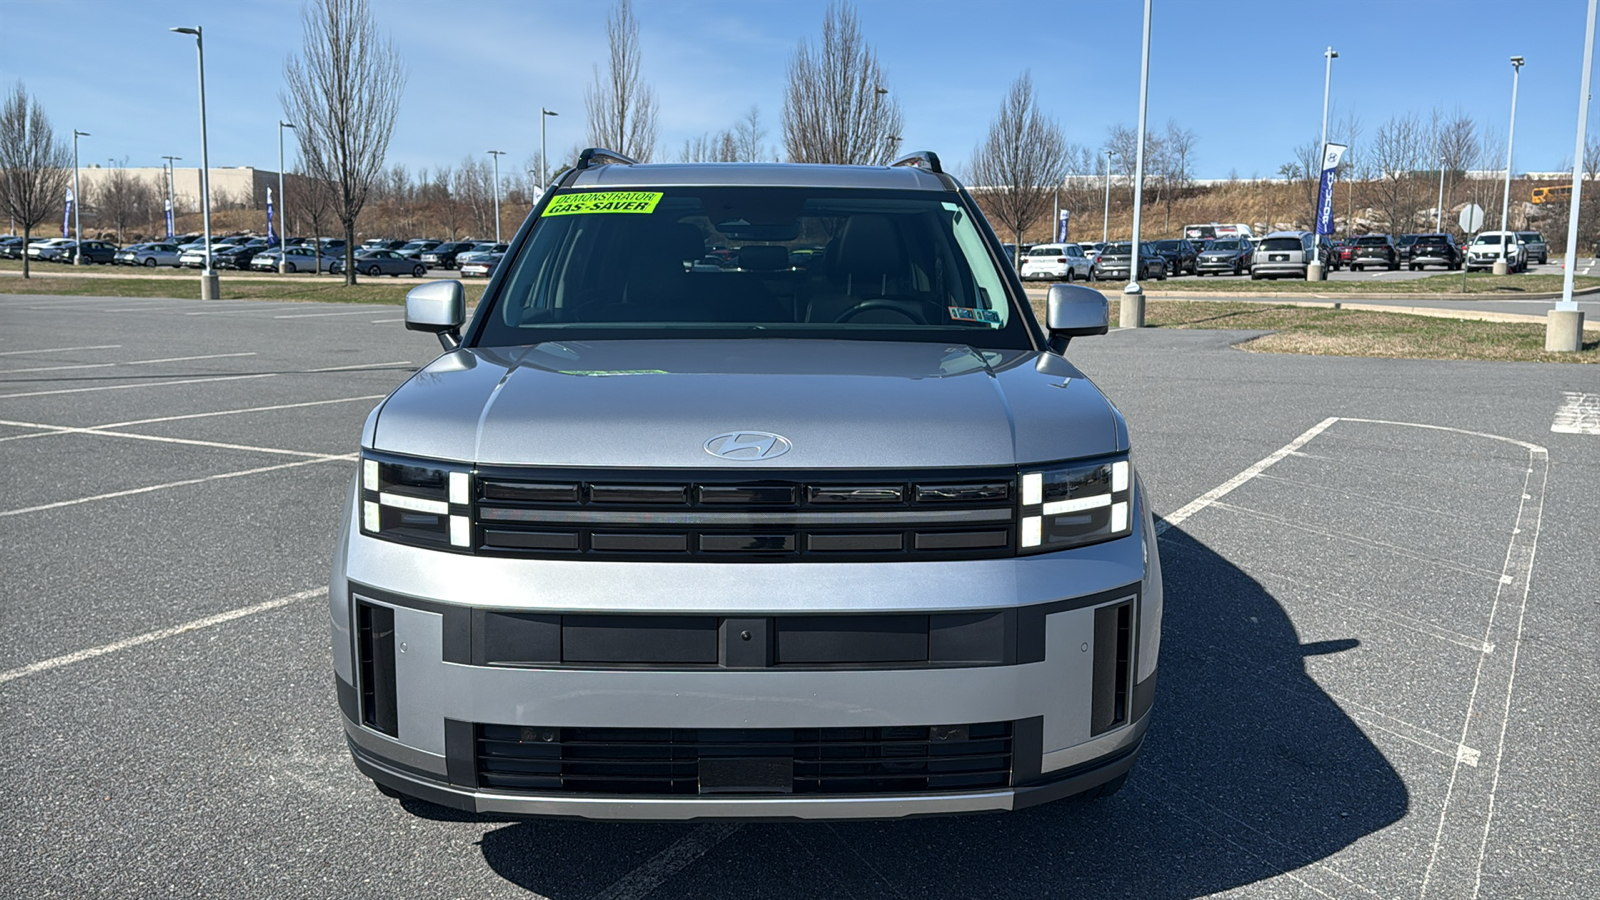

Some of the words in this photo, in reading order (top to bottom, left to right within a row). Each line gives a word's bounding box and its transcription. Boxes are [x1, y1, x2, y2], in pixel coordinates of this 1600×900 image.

[556, 192, 656, 205] DEMONSTRATOR
[1322, 171, 1334, 233] HYUNDAI
[548, 201, 651, 214] GAS-SAVER
